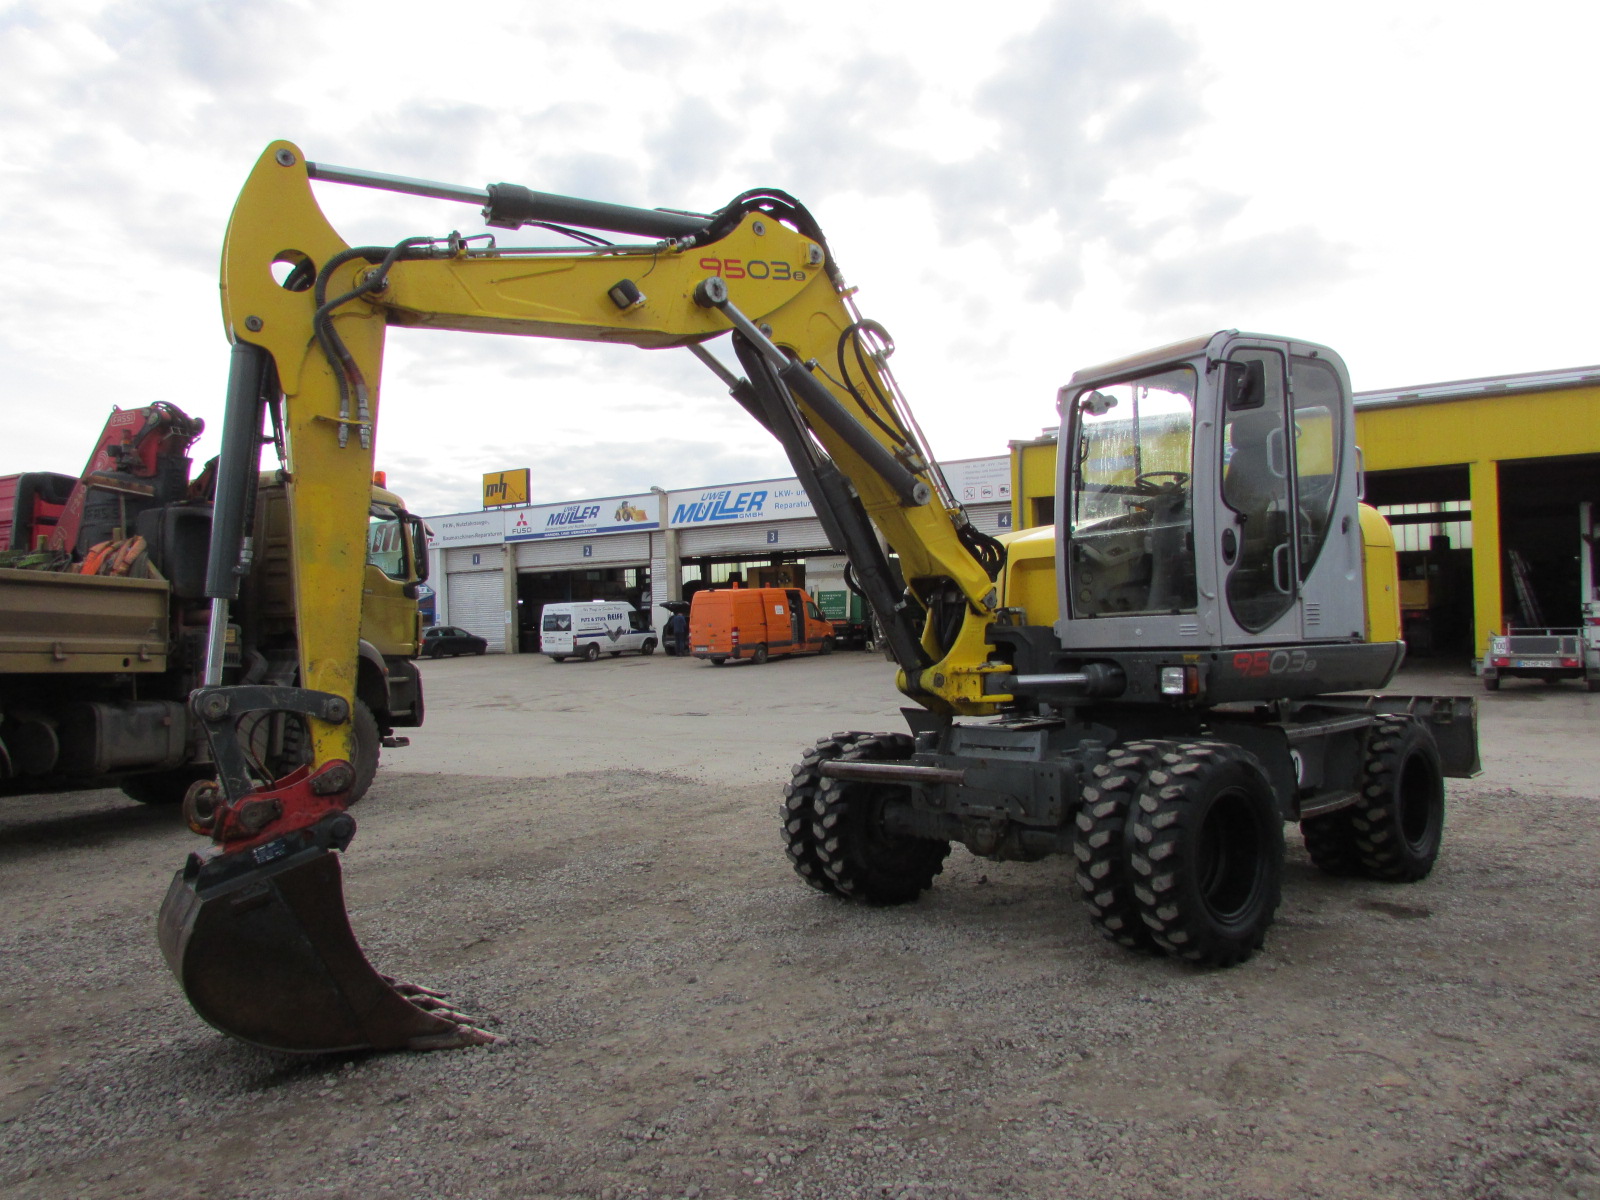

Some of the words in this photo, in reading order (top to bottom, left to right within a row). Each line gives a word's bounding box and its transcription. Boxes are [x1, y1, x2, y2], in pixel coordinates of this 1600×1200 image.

[112, 413, 134, 424] FASSI
[701, 491, 725, 501] UWE
[774, 490, 794, 498] LKW-
[671, 490, 768, 524] MÜLLER
[774, 501, 813, 510] Reparatur
[739, 511, 763, 519] GMBH
[1001, 515, 1008, 525] 4
[771, 533, 775, 542] 3
[586, 546, 590, 556] 2
